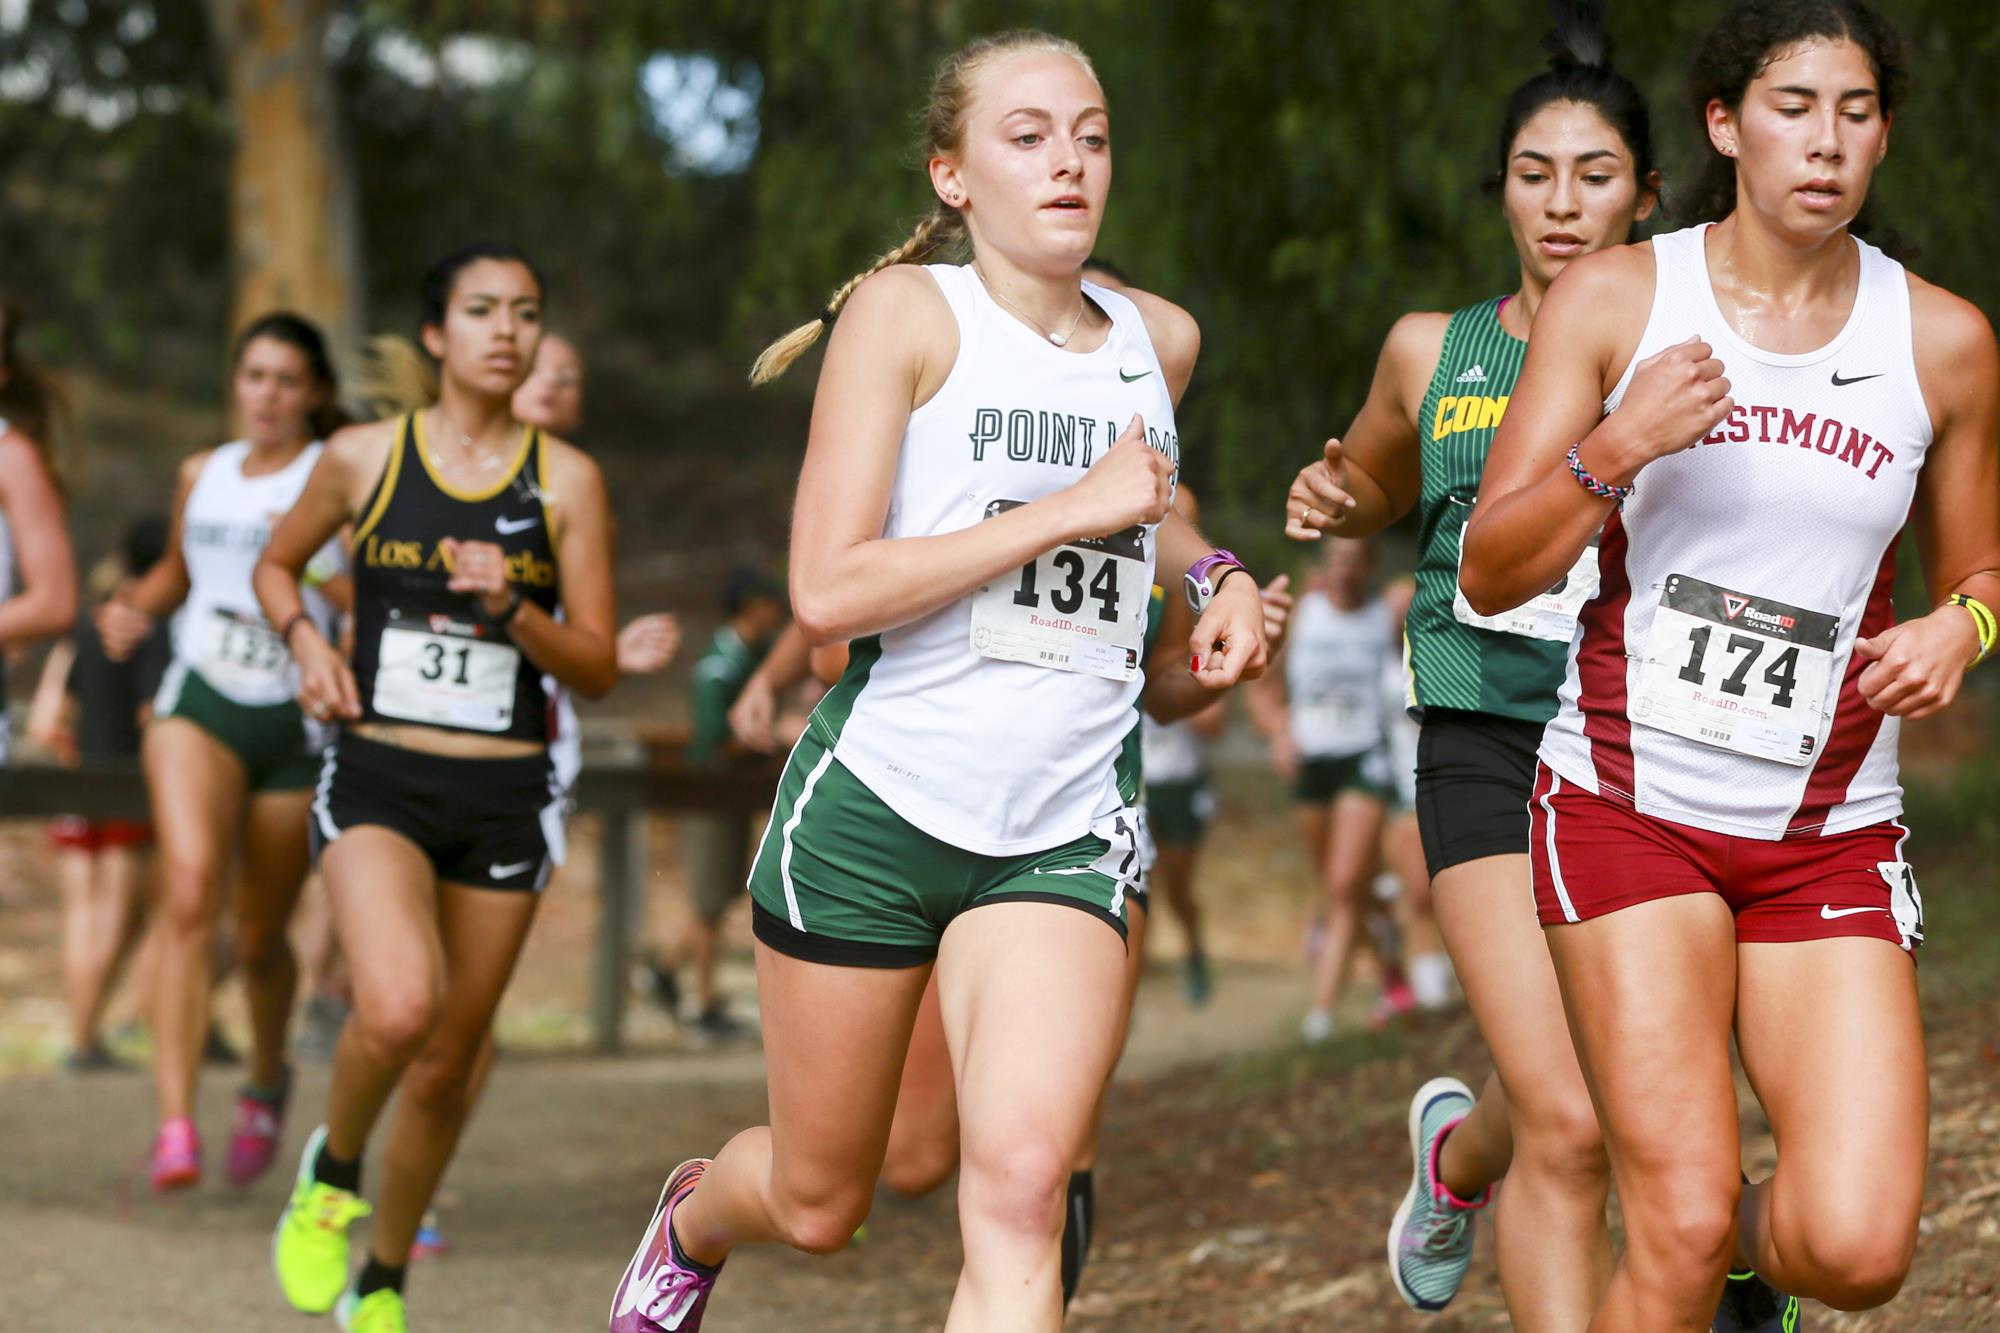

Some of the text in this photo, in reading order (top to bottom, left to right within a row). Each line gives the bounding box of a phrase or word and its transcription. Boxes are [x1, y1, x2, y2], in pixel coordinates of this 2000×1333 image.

[968, 408, 1097, 469] POINT
[1688, 405, 1895, 480] STMONT
[366, 536, 422, 568] Los
[1013, 550, 1120, 623] 134
[1030, 614, 1098, 636] RoadID.com
[1744, 606, 1796, 629] RoadID
[420, 642, 471, 684] 31
[1678, 624, 1800, 709] 174
[1692, 691, 1768, 720] RoadID.com
[886, 763, 921, 781] DRI-FIT
